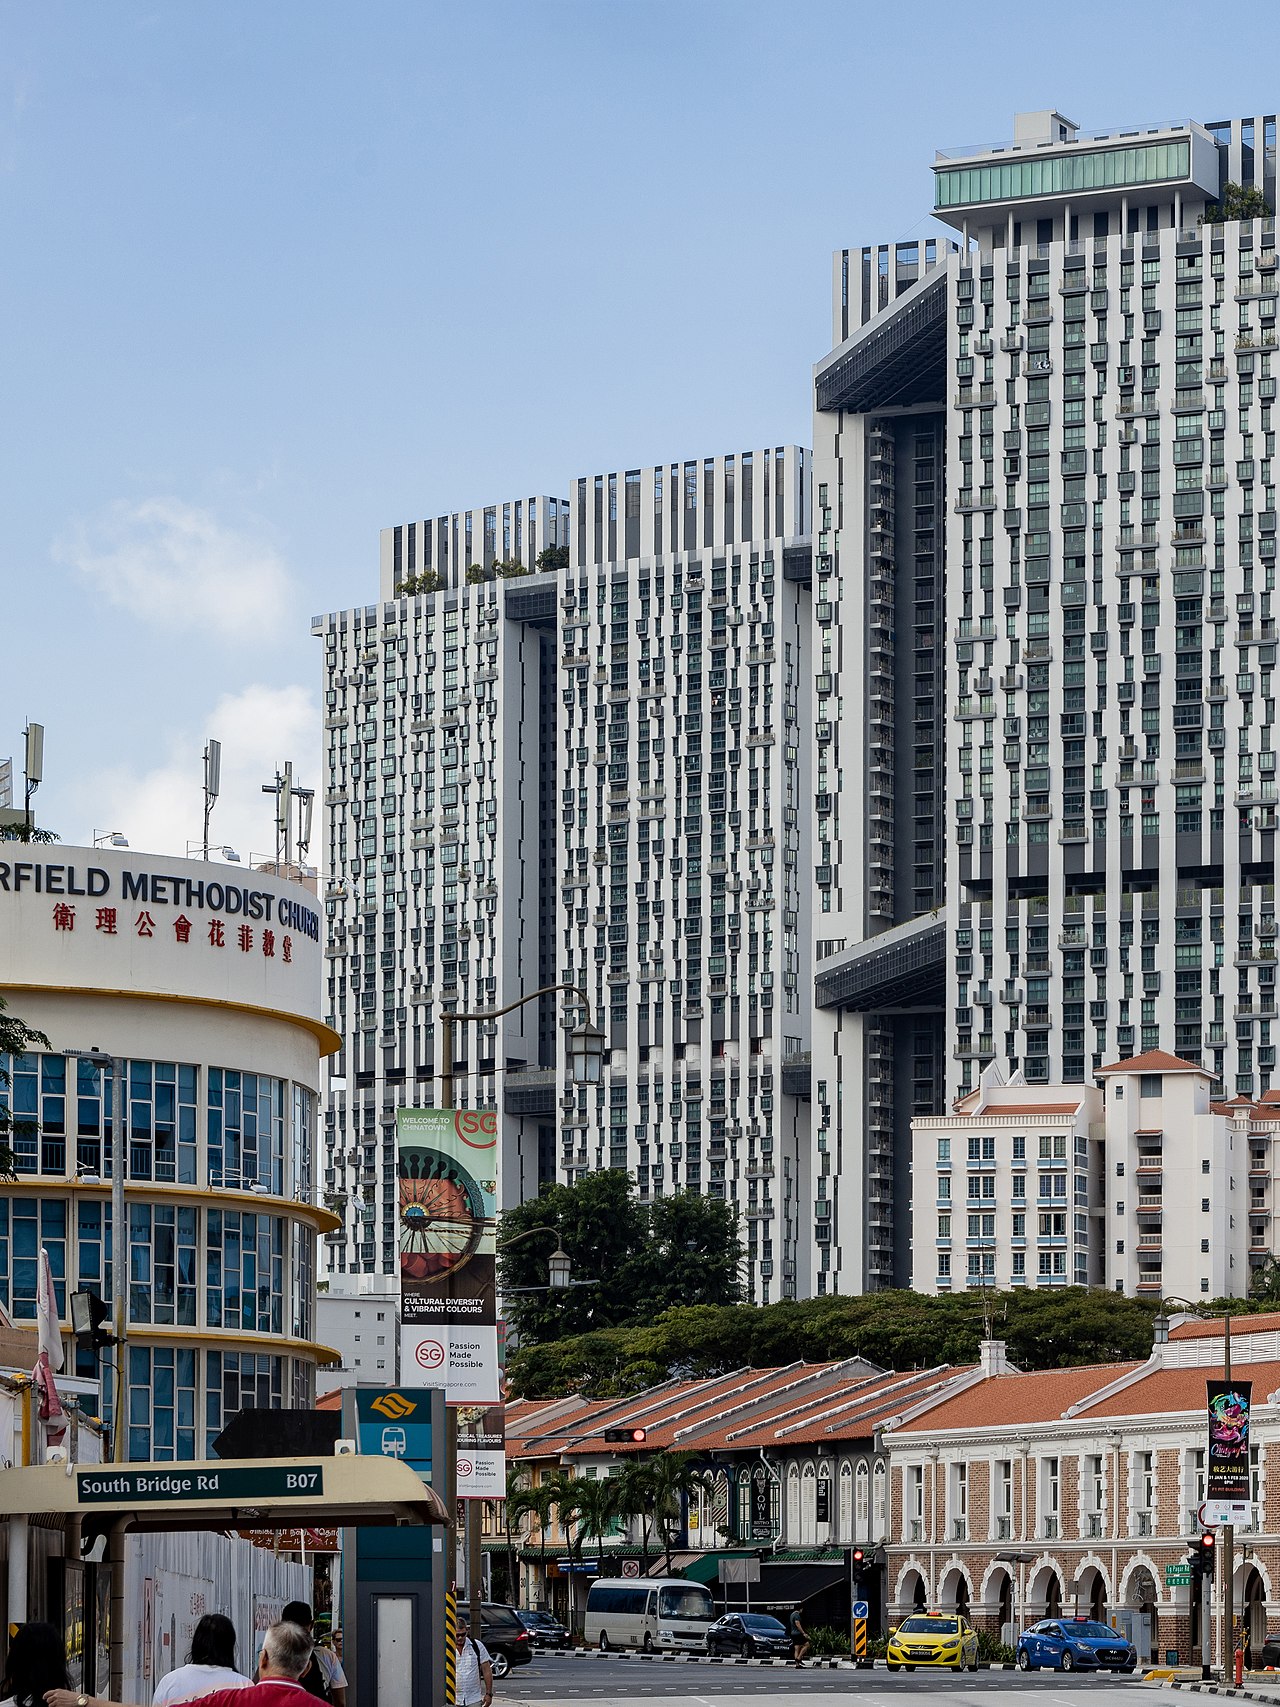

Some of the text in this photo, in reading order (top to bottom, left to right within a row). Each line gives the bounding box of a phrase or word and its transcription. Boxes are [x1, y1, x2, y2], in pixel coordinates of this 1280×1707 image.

[121, 870, 276, 922] METHODIST
[278, 897, 319, 943] CHURCH
[462, 1111, 497, 1134] SG
[449, 1342, 480, 1350] Passion
[419, 1348, 441, 1361] SG
[449, 1351, 472, 1359] Made
[449, 1360, 484, 1368] Possible
[457, 1464, 471, 1472] SG
[82, 1473, 318, 1494] South Bridge Rd B07
